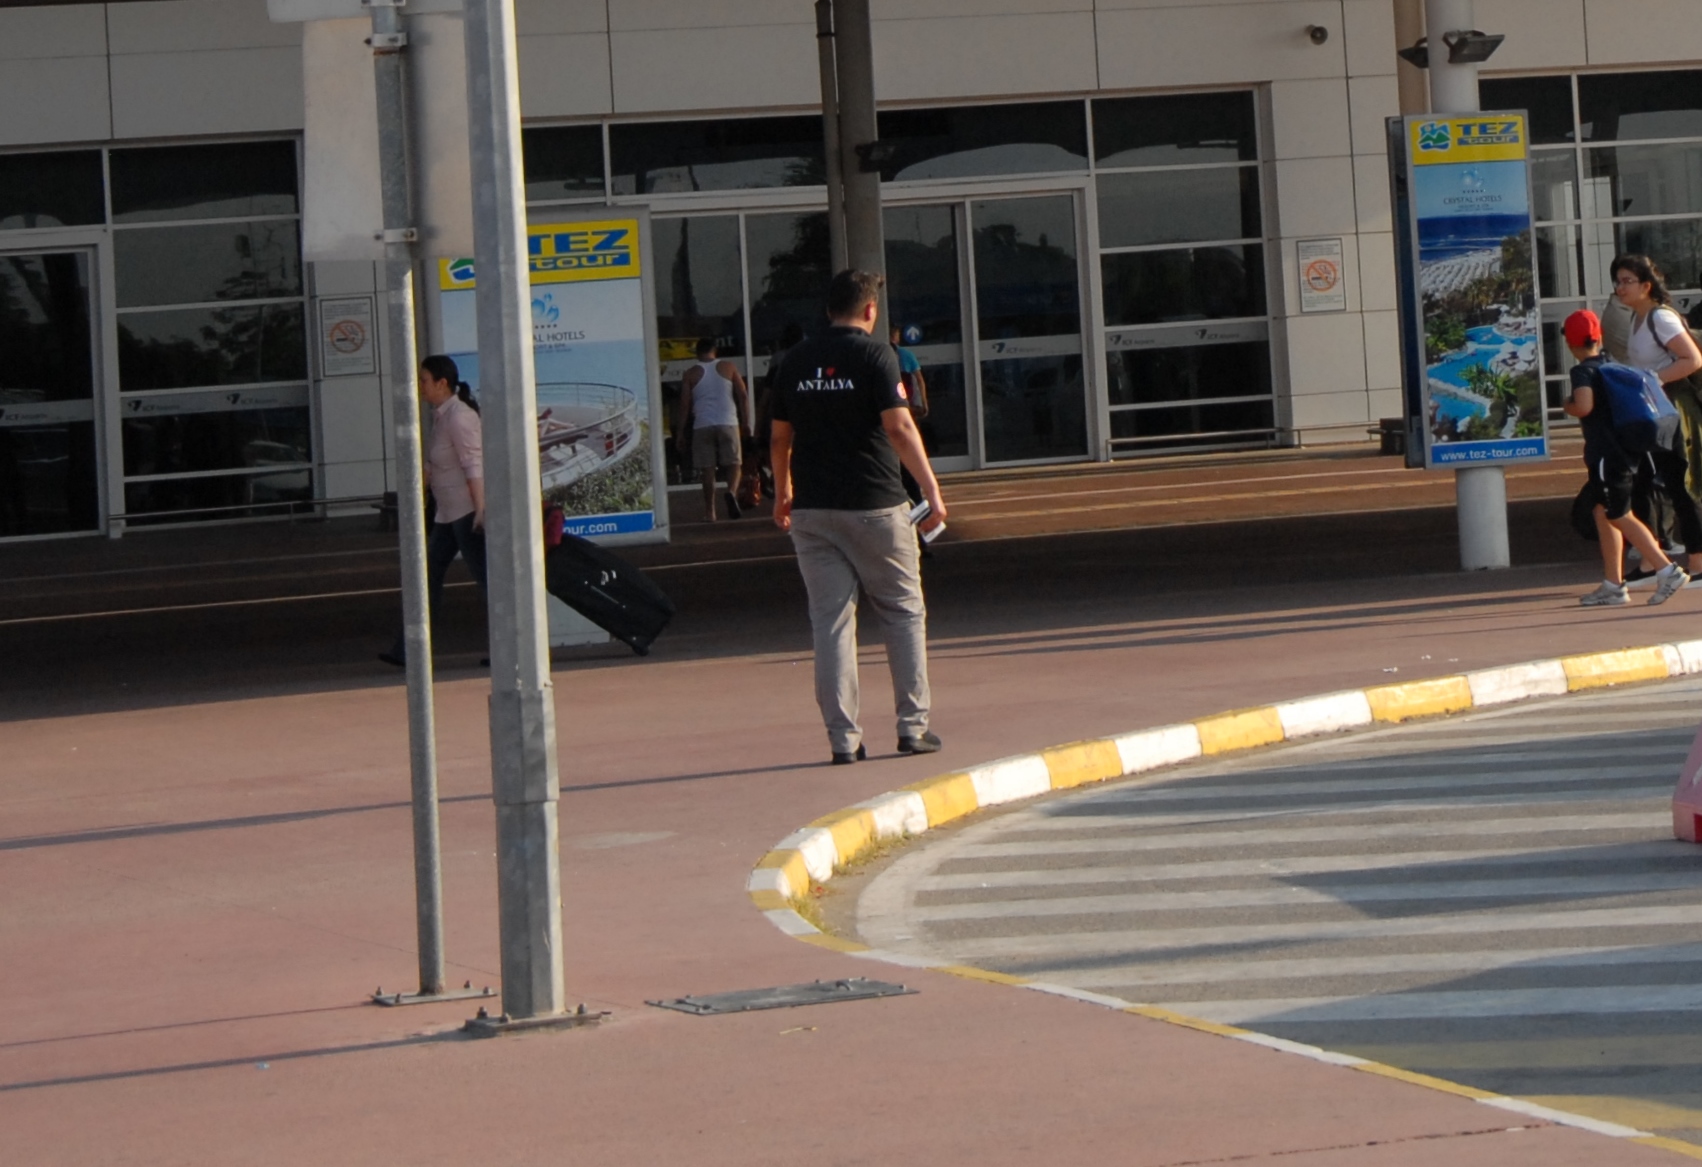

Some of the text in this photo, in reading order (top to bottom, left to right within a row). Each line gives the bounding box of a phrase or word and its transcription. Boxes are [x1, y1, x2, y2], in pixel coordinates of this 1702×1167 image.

[1456, 122, 1518, 136] TEZ
[1475, 194, 1502, 203] HOTELS
[528, 229, 629, 255] TEZ
[535, 254, 620, 269] tour
[546, 331, 585, 342] HOTELS
[816, 367, 823, 378] I
[797, 378, 855, 391] ANTALYA
[1441, 447, 1538, 461] www.tez-tour.com
